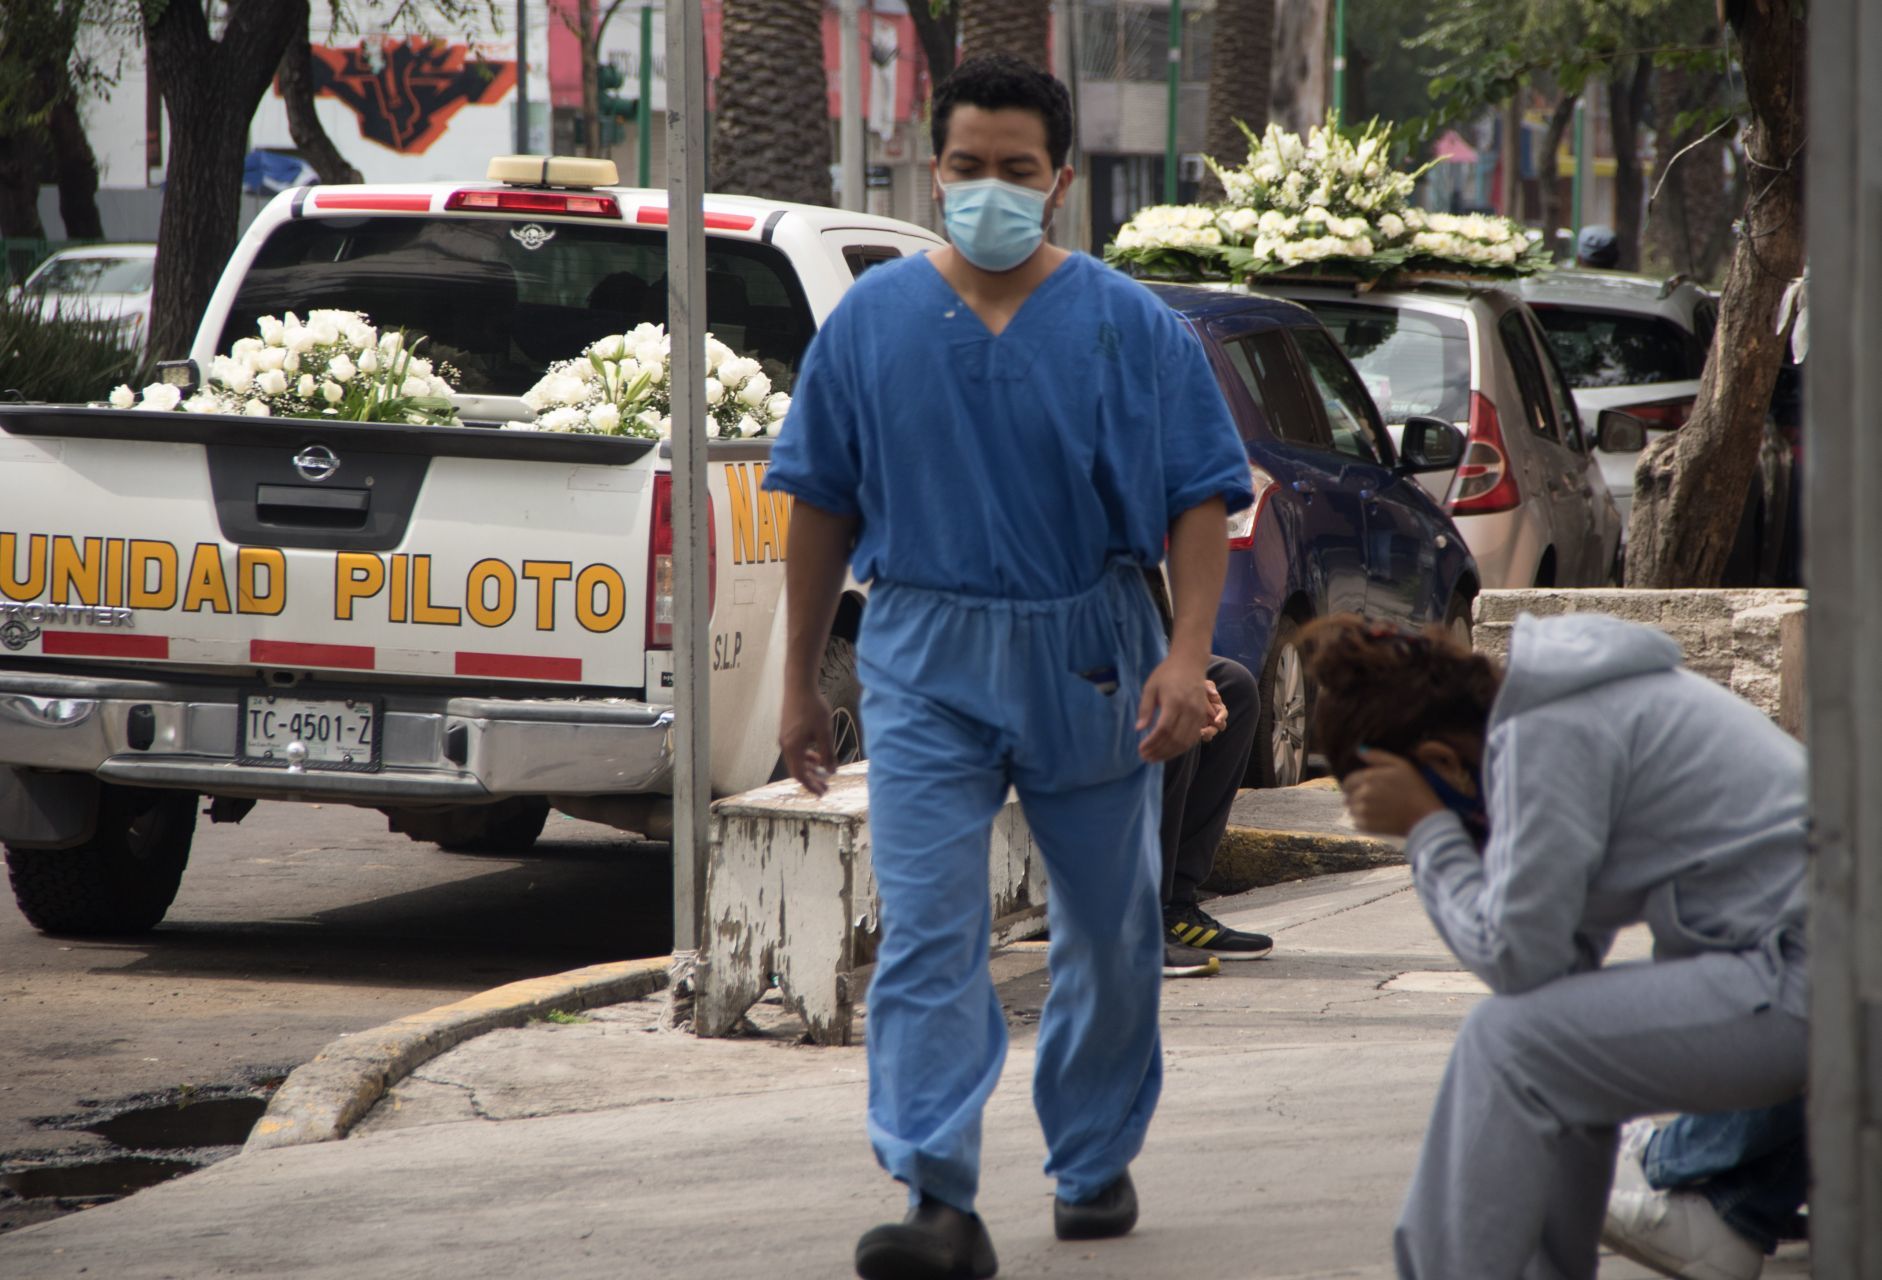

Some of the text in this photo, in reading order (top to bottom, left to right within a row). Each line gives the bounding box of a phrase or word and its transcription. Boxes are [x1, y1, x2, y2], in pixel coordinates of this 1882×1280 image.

[724, 462, 796, 565] NAV
[0, 532, 627, 634] UNIDAD PILOTO
[0, 601, 135, 629] RONTIER
[713, 631, 742, 671] S.L.P.
[249, 709, 371, 744] TC-4501-Z
